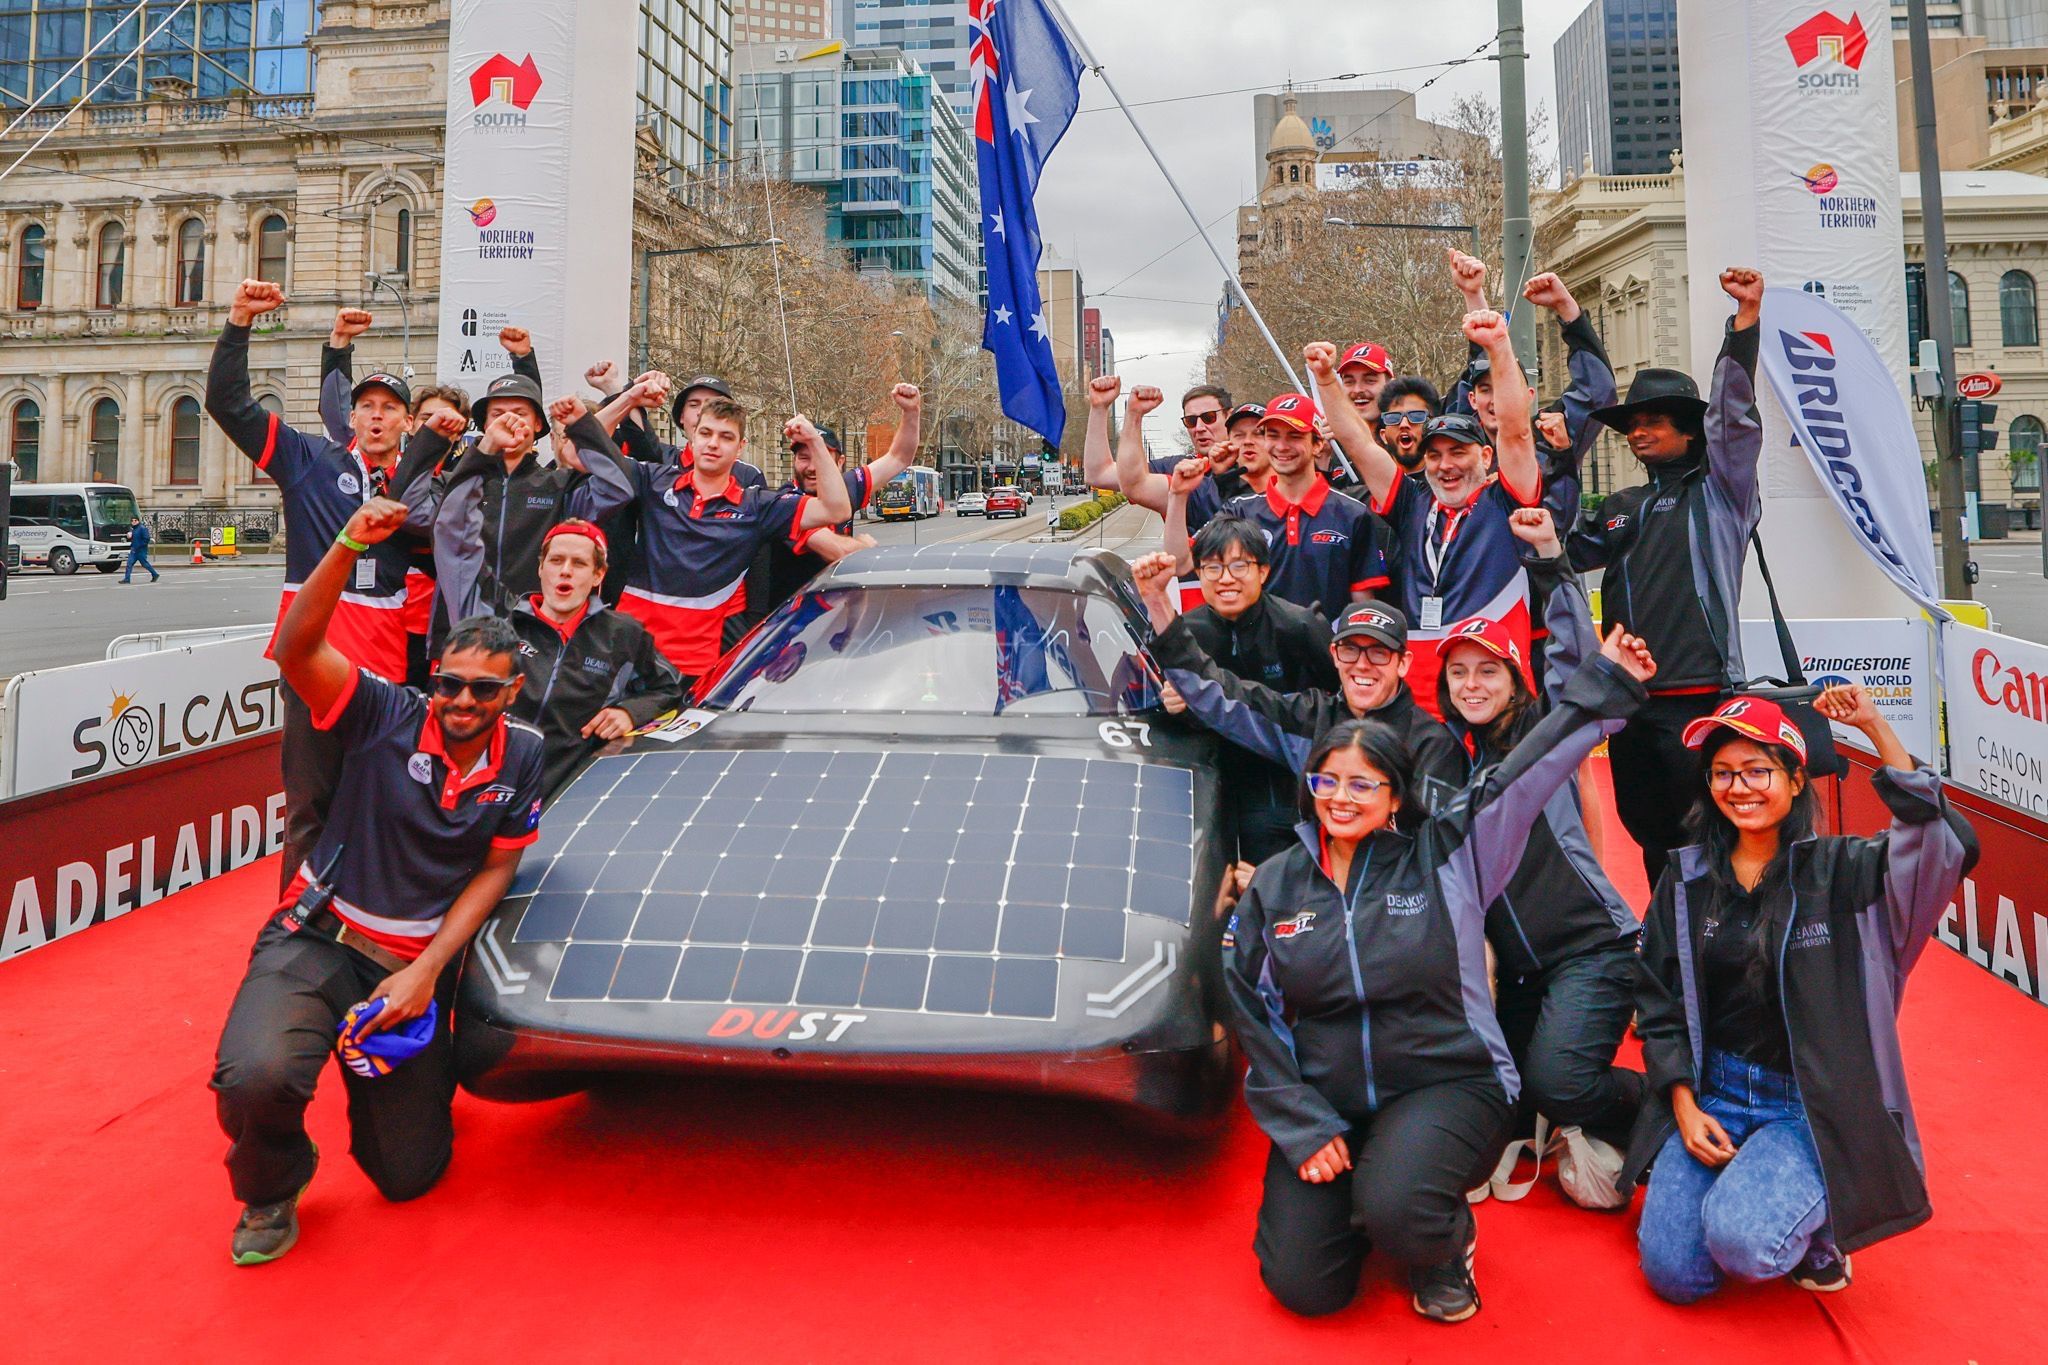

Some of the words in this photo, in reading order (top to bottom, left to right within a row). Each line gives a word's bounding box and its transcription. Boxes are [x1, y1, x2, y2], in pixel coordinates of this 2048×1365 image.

[775, 47, 797, 61] EY
[1798, 73, 1859, 88] SOUTH
[1800, 88, 1860, 97] AUSTRALIA
[474, 113, 527, 127] SOUTH
[474, 127, 526, 136] AUSTRALIA
[1316, 133, 1336, 149] agl
[1820, 197, 1876, 212] NORTHERN
[1820, 213, 1876, 228] TERRITORY
[480, 230, 534, 244] NORTHERN
[479, 245, 533, 259] TERRITORY
[485, 353, 503, 361] CITY
[12, 530, 48, 538] Sightseeing
[1312, 534, 1345, 543] DUST
[1349, 613, 1391, 625] DUST
[1803, 657, 1911, 672] BRIDGESTONE
[1864, 675, 1912, 686] WORLD
[1865, 687, 1912, 698] SOLAR
[1099, 721, 1152, 747] 67
[1977, 736, 2042, 784] CANON
[1979, 768, 2048, 817] SERVIC
[0, 792, 286, 962] ADELAIDE
[1387, 891, 1426, 908] DEAKIN
[1388, 902, 1428, 917] UNIVERSITY
[1789, 922, 1829, 942] DEAKIN
[1789, 936, 1831, 951] UNIVERSITY
[707, 1007, 868, 1042] DUST
